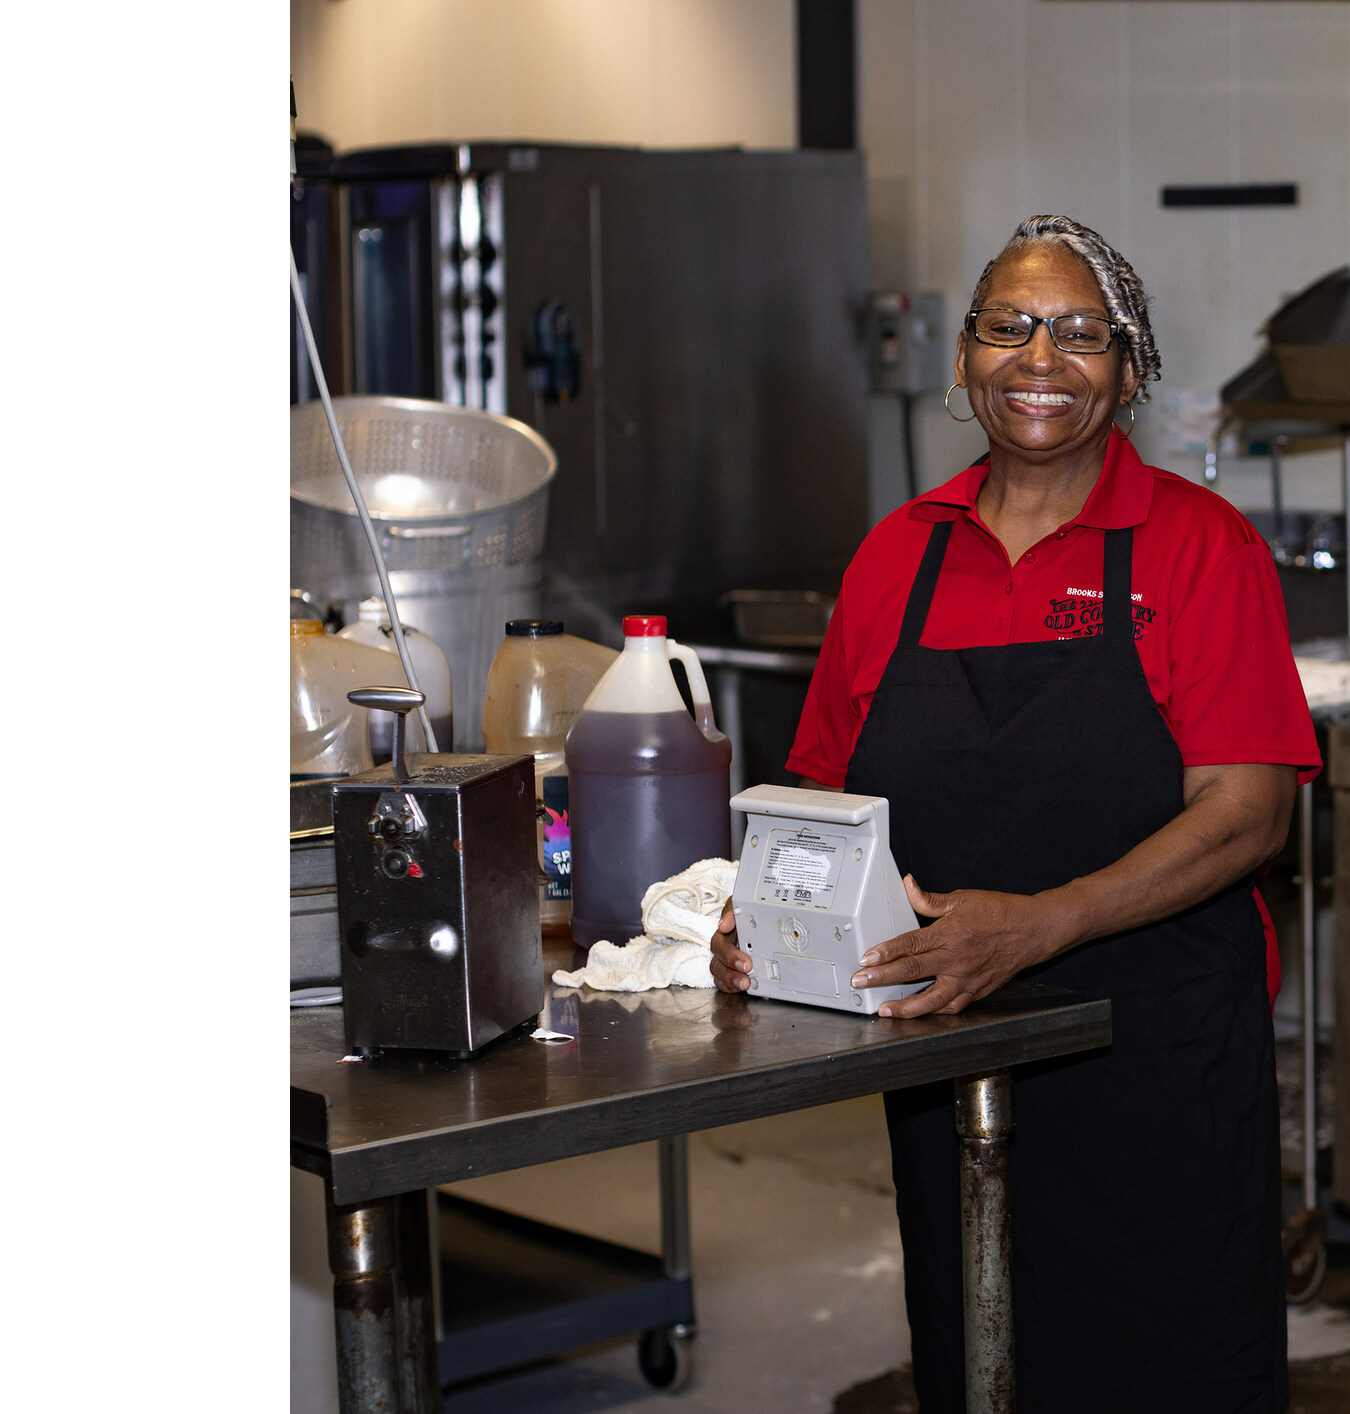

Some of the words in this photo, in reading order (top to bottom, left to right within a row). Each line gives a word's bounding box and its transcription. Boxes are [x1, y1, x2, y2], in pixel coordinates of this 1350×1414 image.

[1066, 588, 1097, 598] BROOKS
[1044, 613, 1076, 630] OLD
[1080, 603, 1156, 625] COTRY
[1084, 620, 1144, 641] STE
